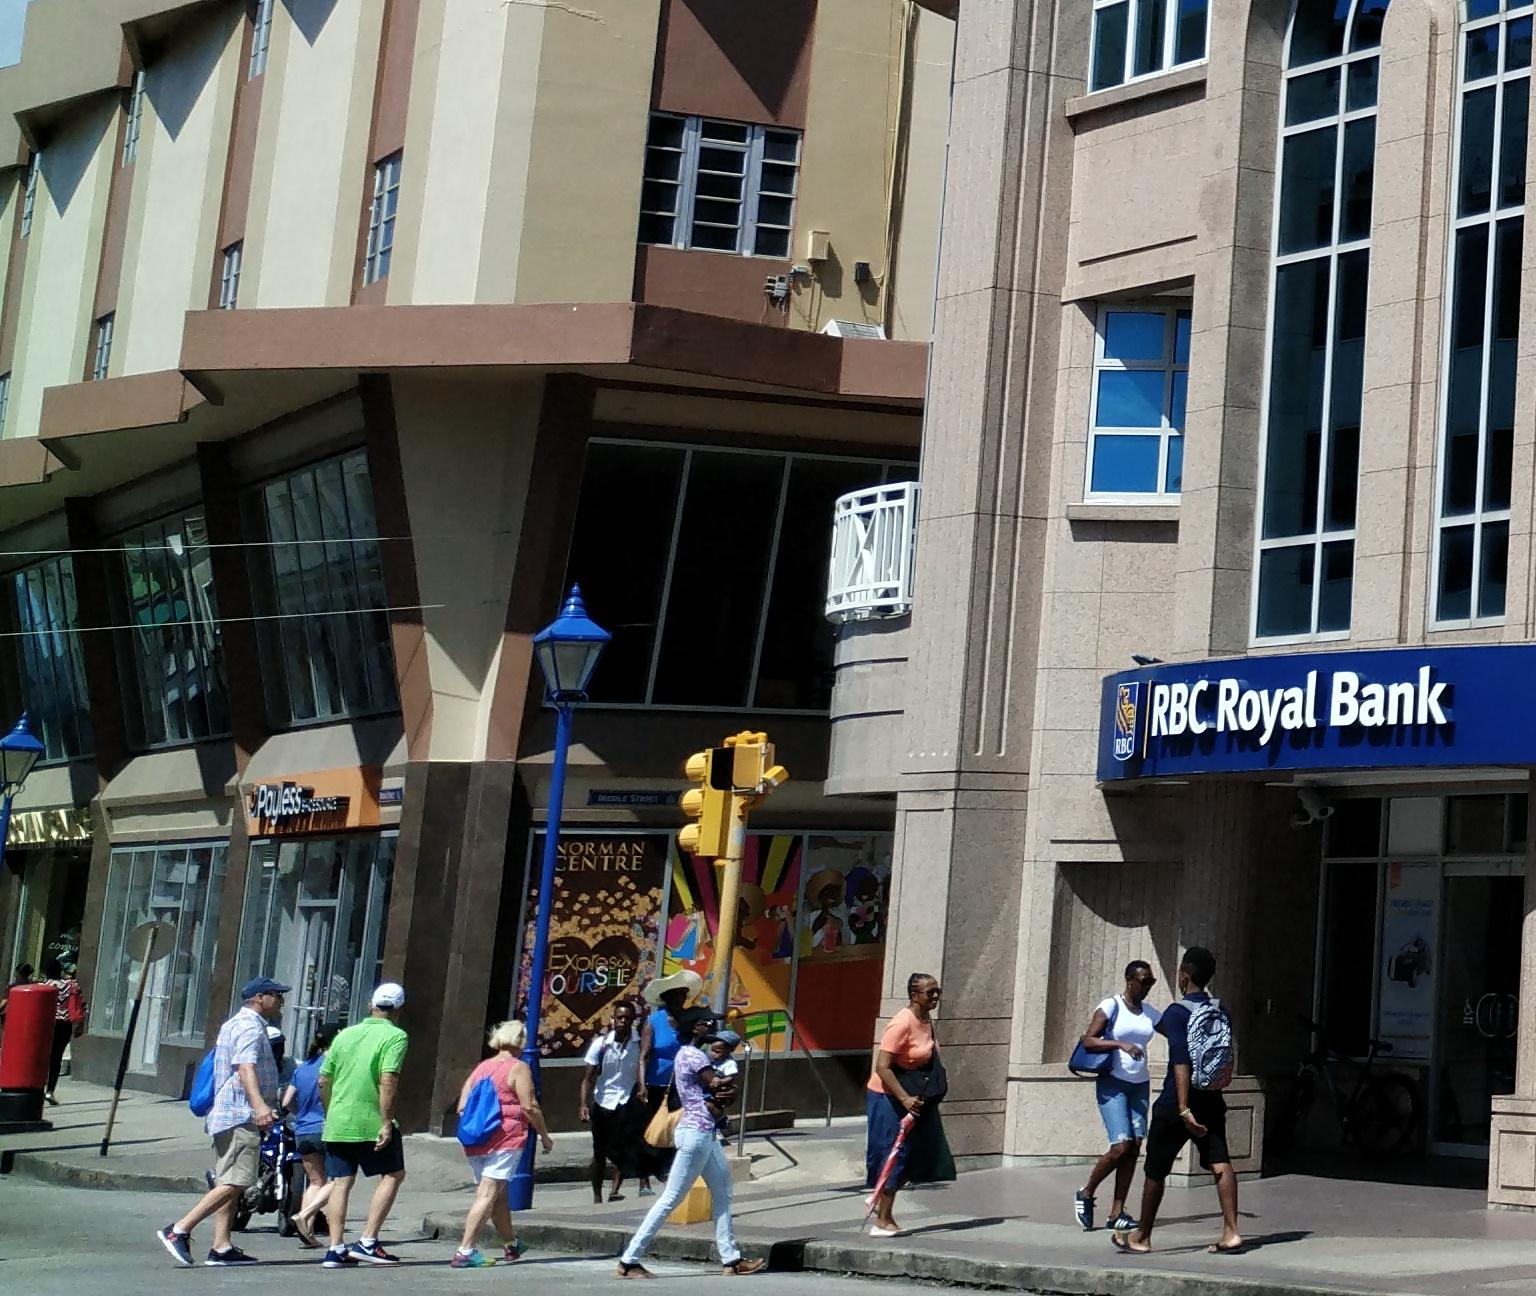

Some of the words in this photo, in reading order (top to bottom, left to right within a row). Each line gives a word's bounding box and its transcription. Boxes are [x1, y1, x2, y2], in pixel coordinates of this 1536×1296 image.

[1151, 680, 1209, 737] RBC
[1217, 670, 1318, 746] Royal
[1330, 665, 1447, 727] Bank
[1115, 738, 1132, 754] RBC
[257, 785, 303, 825] Payless
[557, 842, 645, 855] NORMAN
[556, 855, 643, 872] CENTRE
